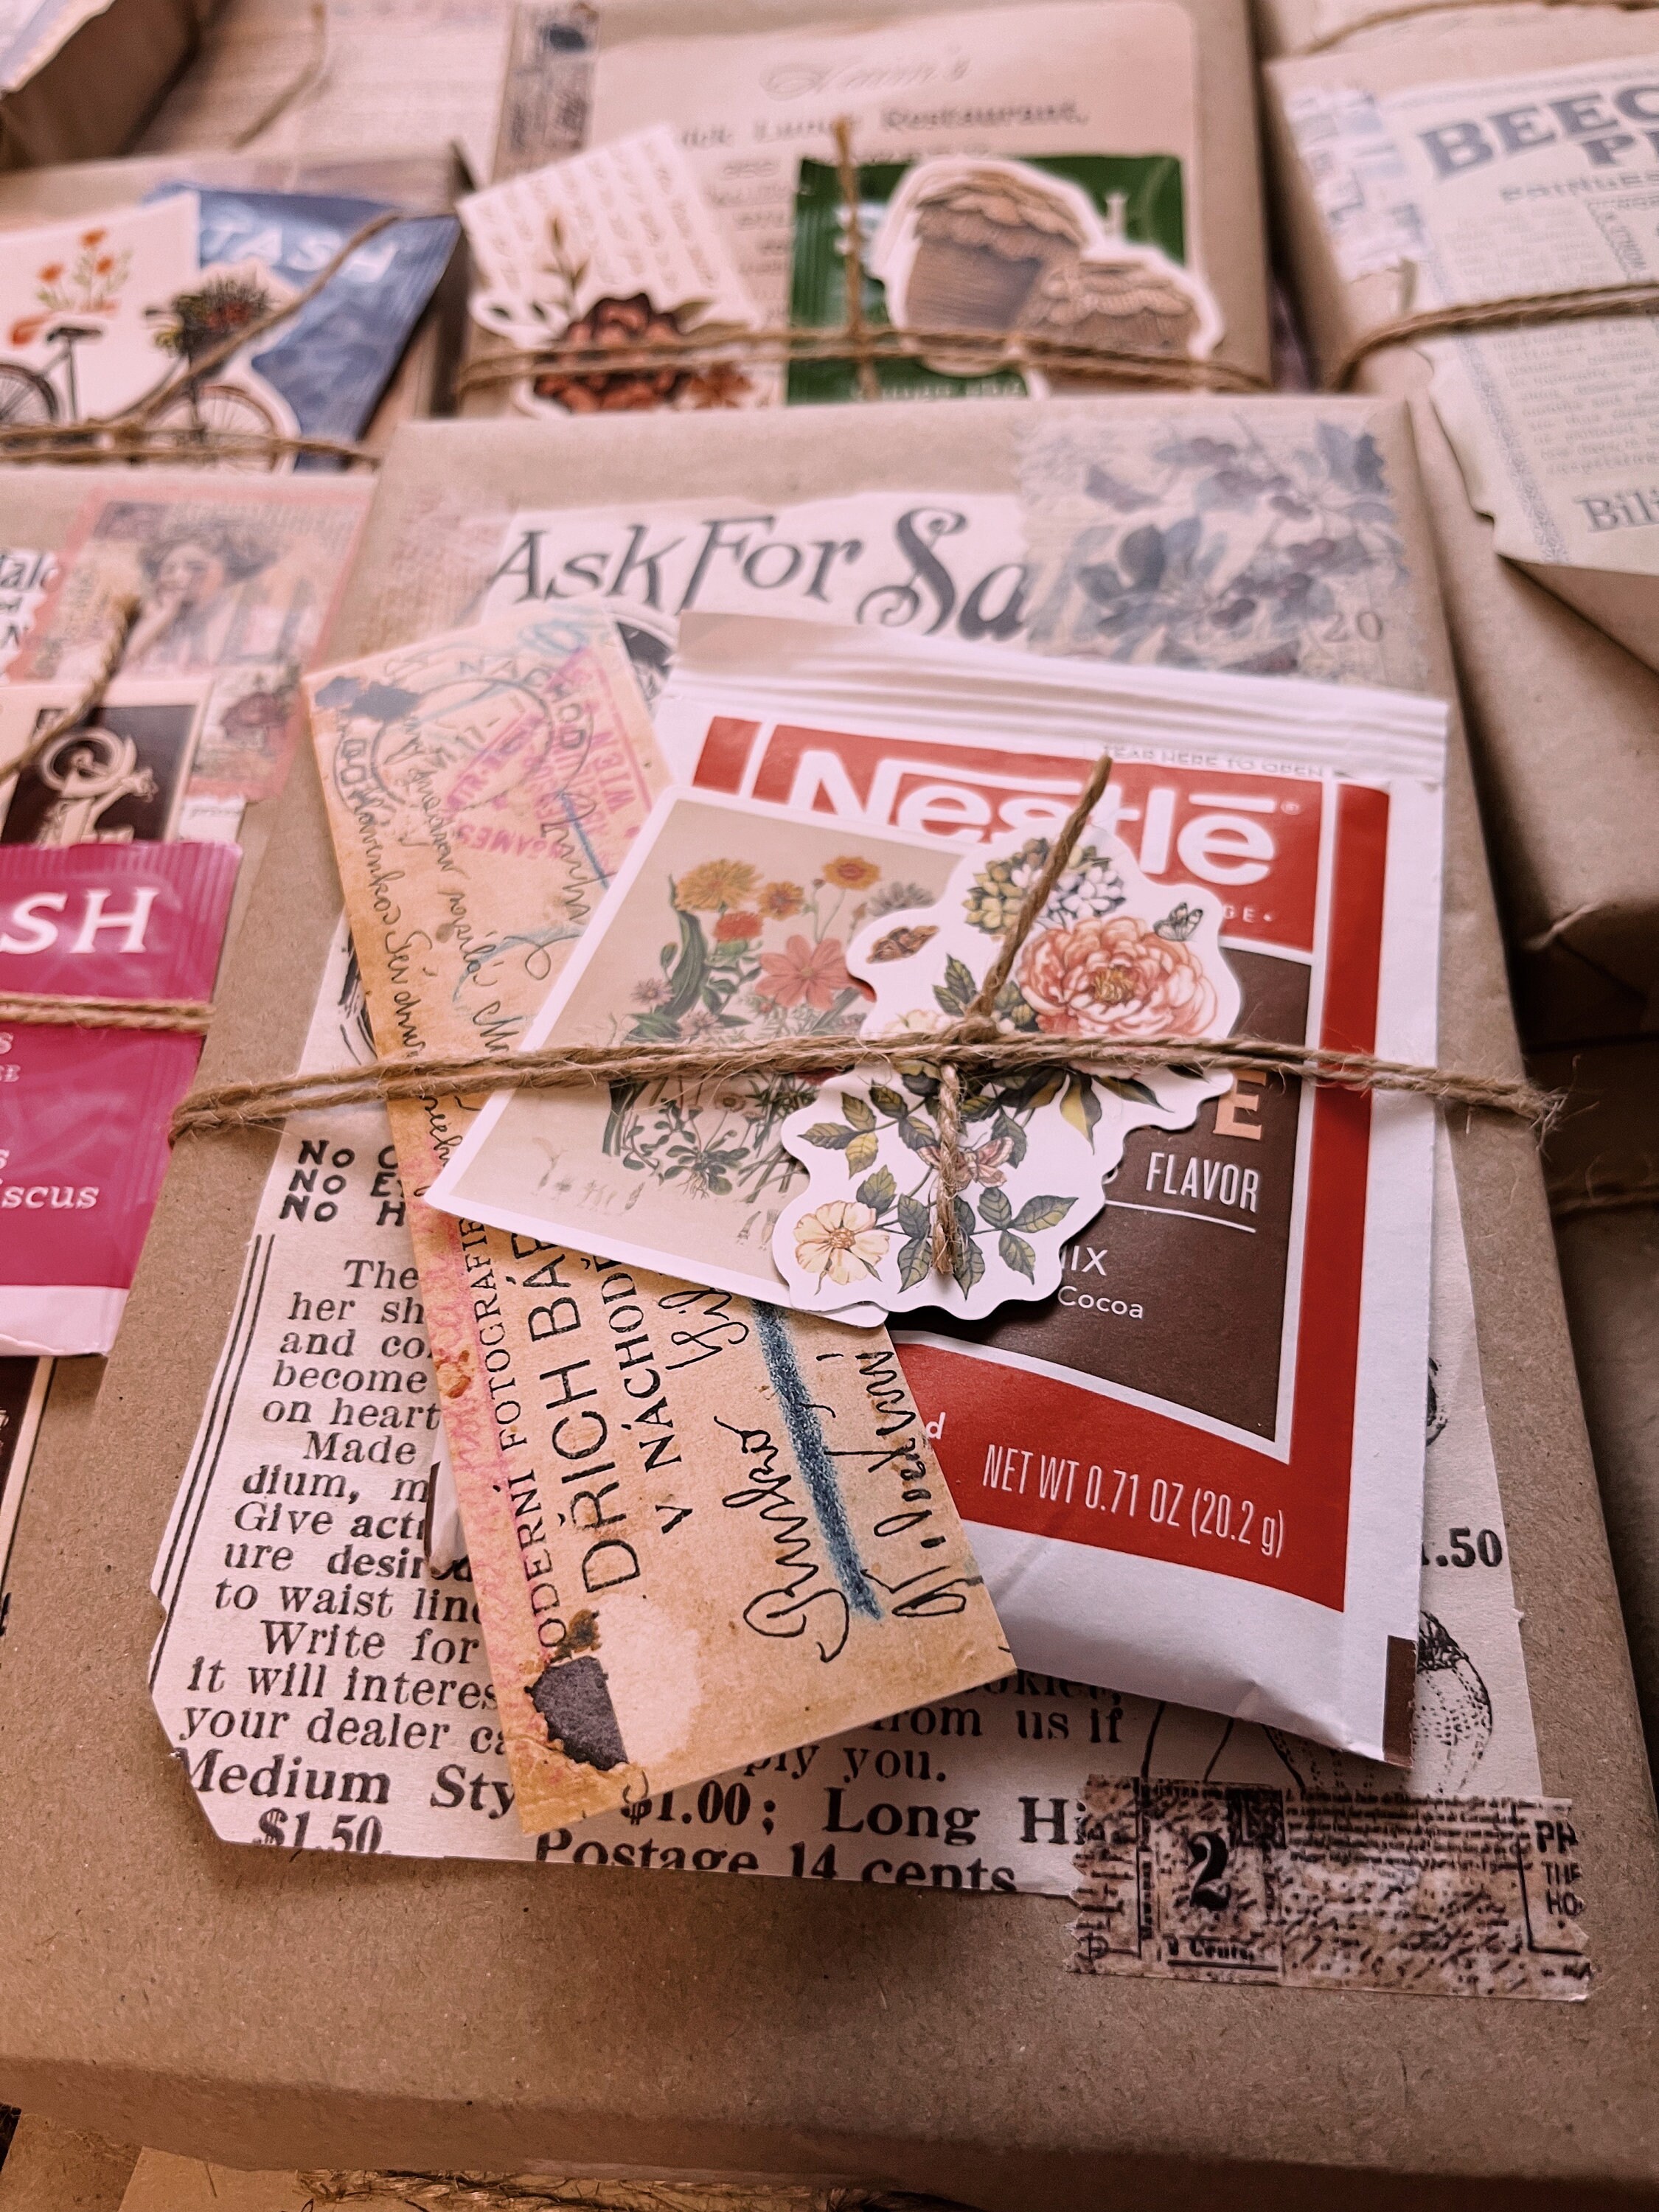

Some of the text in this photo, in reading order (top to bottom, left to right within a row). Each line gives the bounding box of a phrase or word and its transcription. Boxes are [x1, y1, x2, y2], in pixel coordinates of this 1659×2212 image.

[485, 522, 686, 613] Ask
[675, 512, 863, 615] For
[1161, 751, 1219, 769] HERE
[1226, 757, 1253, 771] TO
[1260, 762, 1325, 778] OPEN
[369, 1172, 405, 1199] E
[1145, 1151, 1259, 1214] FLAVOR
[344, 1259, 420, 1291] The
[1059, 1244, 1109, 1277] IX
[286, 1291, 356, 1322] her
[1057, 1284, 1144, 1320] Cocoa
[279, 1328, 434, 1360] and co
[271, 1359, 428, 1394] become
[262, 1397, 442, 1431] on heart
[302, 1430, 418, 1466] Made
[242, 1463, 361, 1505] dium,
[982, 1443, 1286, 1559] NET WT 0.71 OZ (20.2 g)
[233, 1500, 334, 1536] Give
[224, 1541, 295, 1572] ure
[215, 1577, 259, 1610] to
[279, 1582, 394, 1620] waist
[260, 1619, 480, 1666] Write for
[187, 1655, 226, 1694] it
[248, 1661, 328, 1699] will
[178, 1706, 291, 1742] your
[306, 1706, 451, 1750] dealer
[1015, 1708, 1070, 1739] us
[1088, 1705, 1124, 1745] if
[174, 1746, 392, 1805] Medium
[843, 1747, 947, 1784] you.
[822, 1786, 981, 1847] Long
[535, 1827, 1018, 1893] Postage 14 cents
[1186, 1831, 1232, 1911] 2
